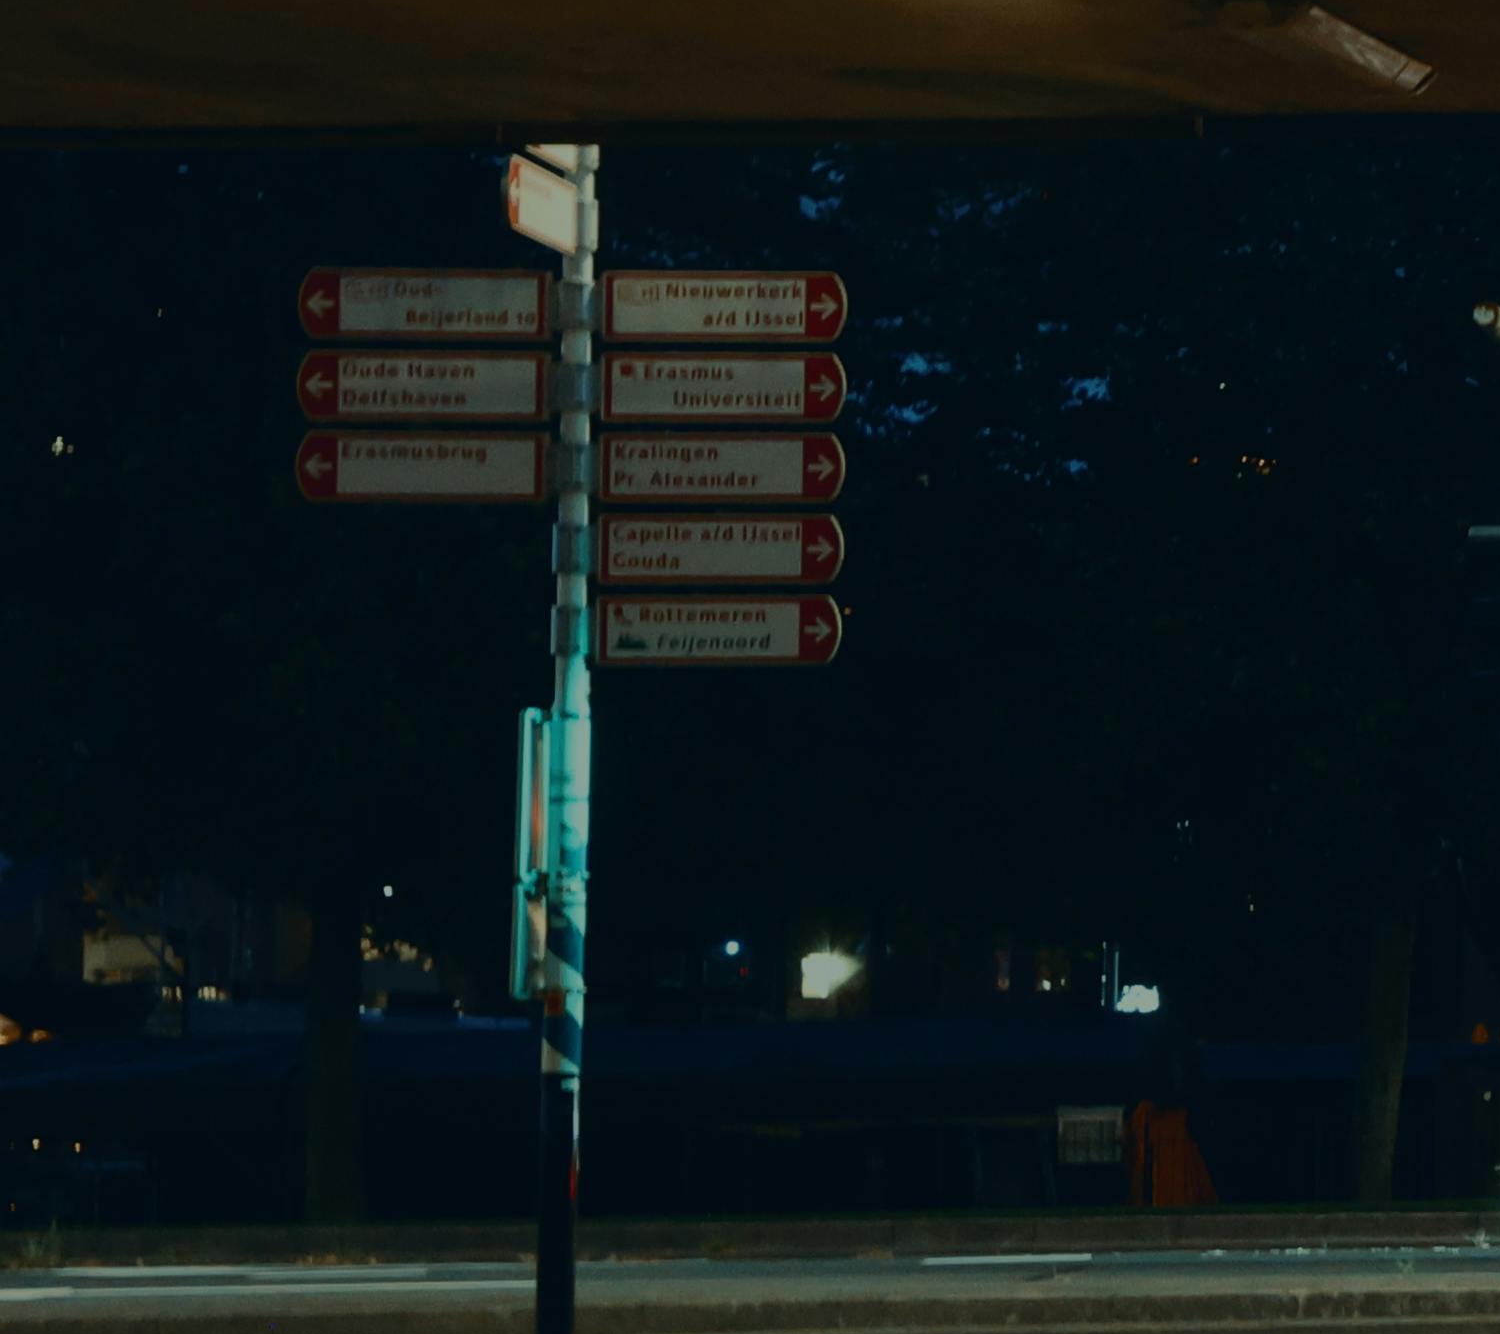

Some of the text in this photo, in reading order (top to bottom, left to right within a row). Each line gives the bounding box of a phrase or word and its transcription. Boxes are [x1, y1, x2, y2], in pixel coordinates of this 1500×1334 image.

[703, 310, 736, 327] a/d
[341, 362, 475, 380] Oude Haven
[643, 364, 734, 381] Erasmus
[341, 389, 467, 408] Delfshaven
[672, 390, 801, 409] Universiteit
[341, 441, 488, 464] Erasmusbrug
[613, 442, 718, 463] Kralingen
[650, 470, 759, 488] Alexander
[612, 525, 692, 546] Capelle
[700, 525, 734, 542] a/d
[612, 552, 681, 570] Gouda
[639, 607, 767, 623] Rottemeren
[656, 633, 772, 655] Feijenoord
